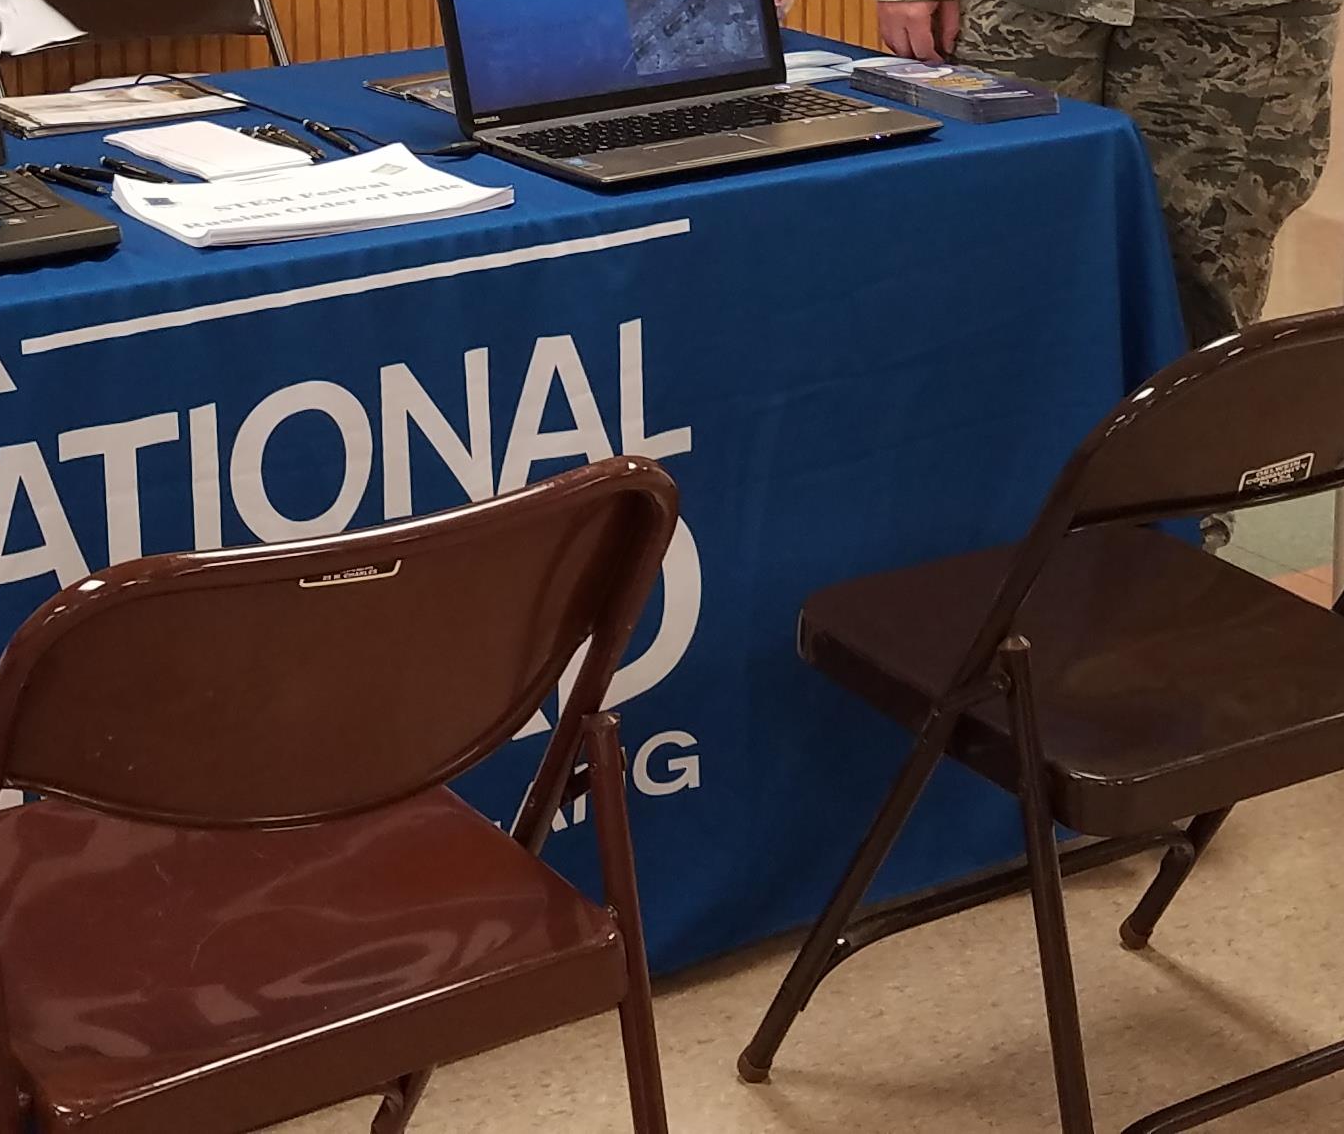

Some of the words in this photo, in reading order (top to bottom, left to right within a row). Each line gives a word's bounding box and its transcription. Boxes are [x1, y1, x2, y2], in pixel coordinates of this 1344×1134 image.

[183, 210, 282, 229] Russian
[285, 197, 360, 215] Order
[365, 192, 393, 203] of
[397, 181, 465, 199] Battle
[213, 195, 296, 212] STEM
[301, 181, 390, 199] Festival
